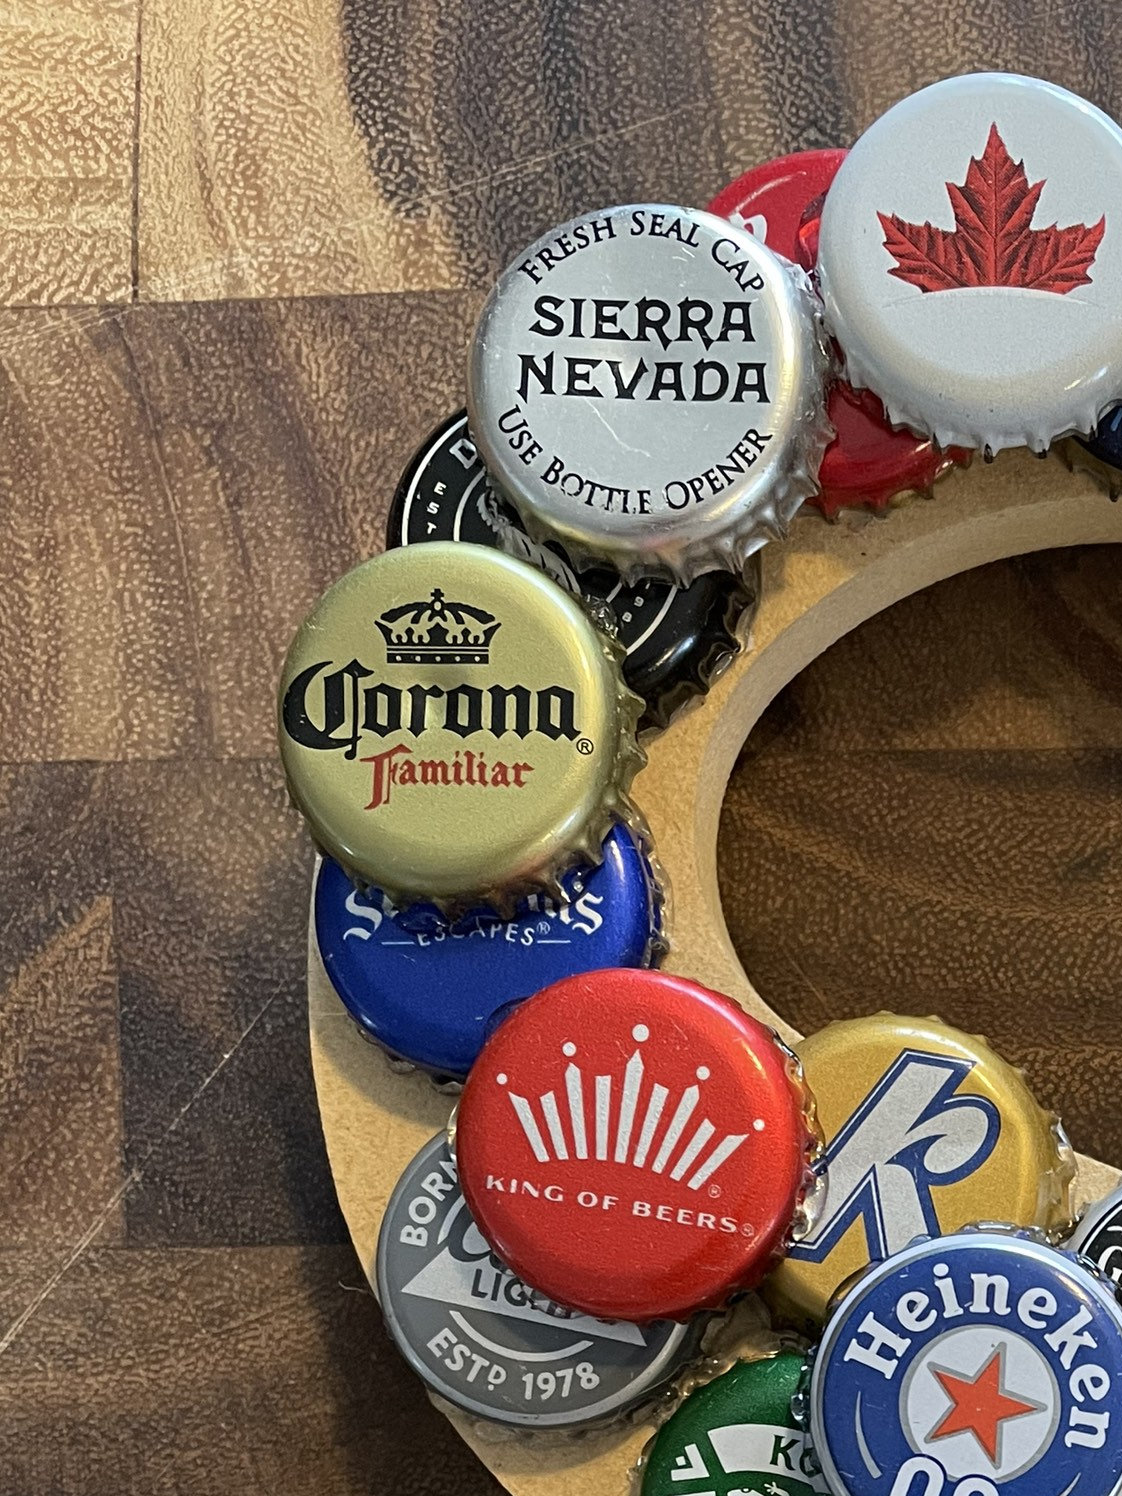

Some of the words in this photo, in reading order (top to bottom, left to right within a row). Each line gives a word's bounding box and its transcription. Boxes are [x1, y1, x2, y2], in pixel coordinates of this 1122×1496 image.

[517, 216, 616, 284] FRESH
[630, 211, 700, 248] SEAL
[711, 238, 765, 292] CAP
[529, 295, 755, 351] SIERRA
[516, 351, 771, 403] NEVADA
[498, 404, 543, 465] USE
[541, 457, 652, 514] BOTTLE
[666, 426, 773, 511] OPENER
[283, 658, 582, 761] Corona
[360, 744, 535, 810] Familiar
[485, 1174, 564, 1203] KING
[577, 1191, 619, 1210] OF
[632, 1201, 738, 1234] BEERS
[522, 1362, 600, 1401] 1978
[843, 1263, 1111, 1451] Heineken
